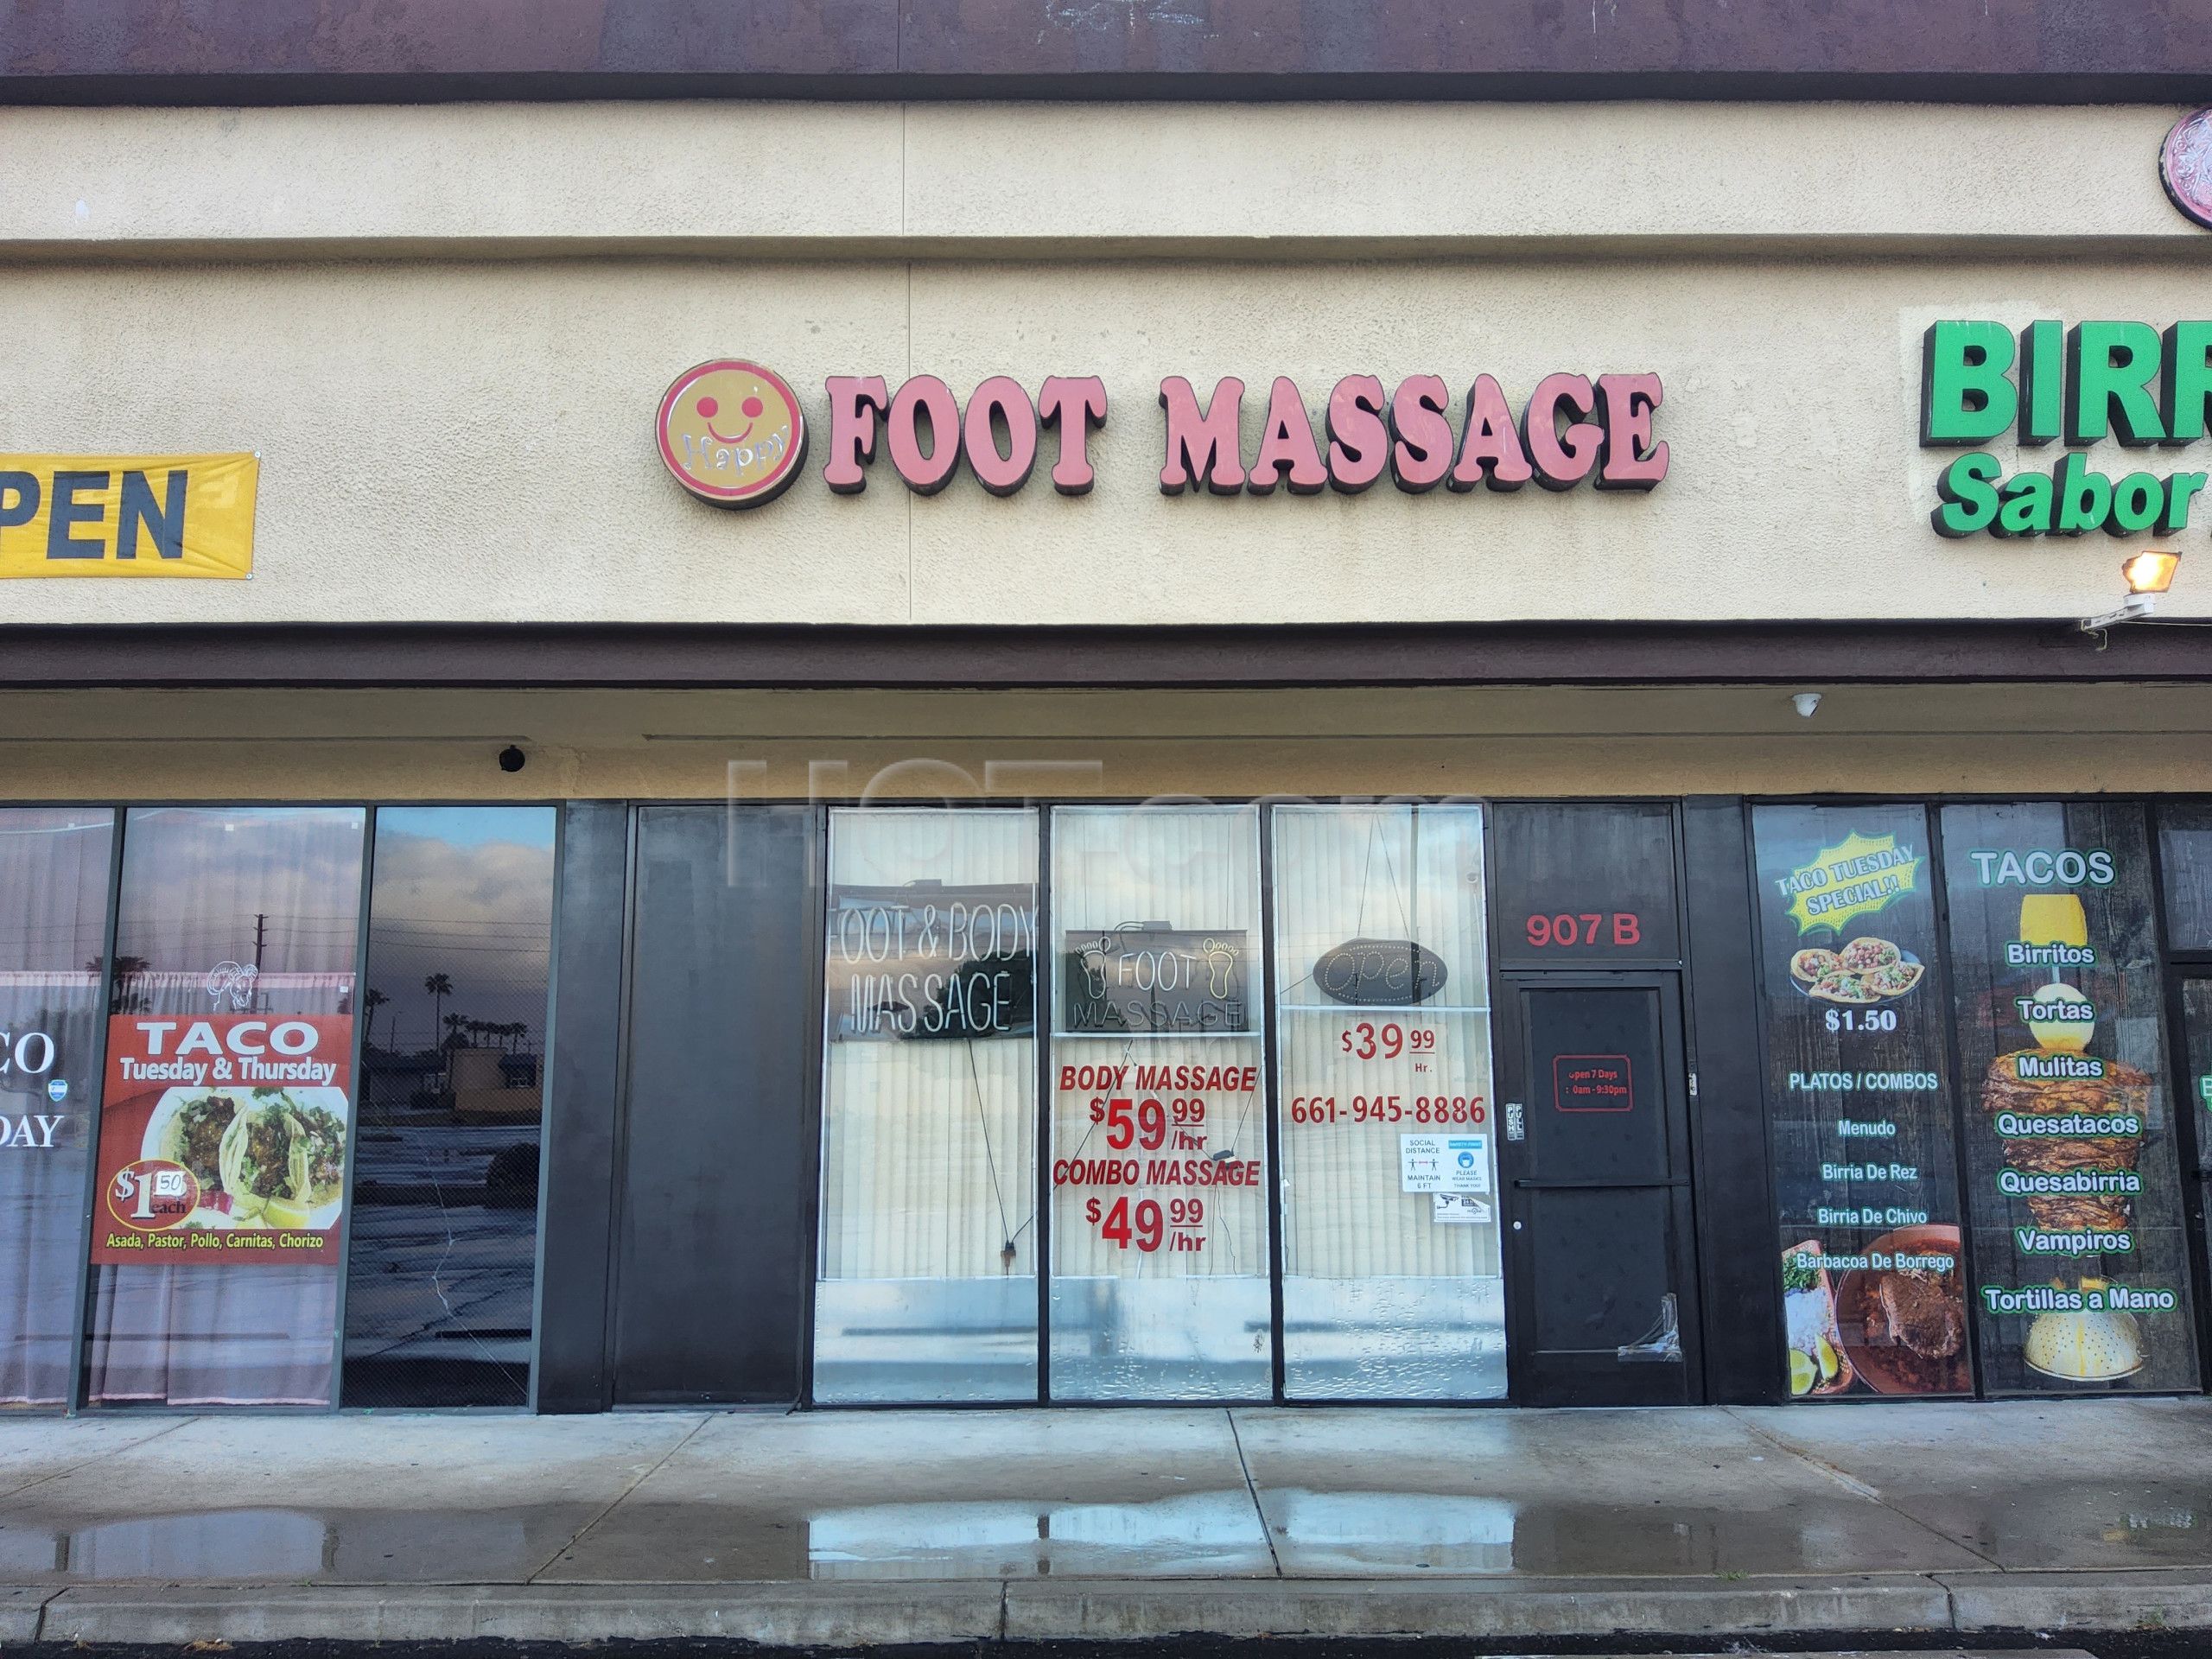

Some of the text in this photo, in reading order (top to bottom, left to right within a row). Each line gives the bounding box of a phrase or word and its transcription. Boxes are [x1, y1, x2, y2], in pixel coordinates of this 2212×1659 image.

[823, 372, 1670, 496] FOOT MASSAGE
[682, 424, 787, 478] Happy
[1930, 452, 2209, 538] Sabor
[1775, 843, 1915, 896] TACO TUESDAY
[1971, 850, 2114, 884] TACOS
[1806, 875, 1899, 914] SPECIAL!!
[918, 904, 937, 959] &
[949, 902, 1039, 962] BODY
[1526, 912, 1641, 946] 907 B
[2007, 944, 2094, 964] Birritos
[1118, 951, 1197, 992] FOOT
[850, 970, 1010, 1033] MASSAGE
[1073, 1001, 1243, 1027] MASSAGE
[2018, 999, 2094, 1020] Tortas
[1825, 1008, 1897, 1033] $1.50
[137, 1021, 319, 1055] TACO
[1341, 1022, 1435, 1060] $39 99
[120, 1057, 337, 1085] Tuesday & Thursday
[1059, 1065, 1257, 1091] BODY MASSAGE
[1414, 1063, 1433, 1072] Hr.
[1591, 1070, 1597, 1078] 7
[1598, 1070, 1618, 1080] Days
[2018, 1057, 2102, 1077] Mulitas
[1566, 1085, 1591, 1094] 0am
[1596, 1084, 1627, 1096] 9:30pm
[1789, 1072, 1938, 1090] PLATOS / COMBOS
[1291, 1096, 1485, 1124] 661-945-8886
[1090, 1096, 1205, 1150] $59 99
[1838, 1119, 1896, 1135] Menudo
[1998, 1114, 2139, 1135] Quesatacos
[1172, 1130, 1208, 1150] /hr
[160, 1174, 181, 1191] 50
[1053, 1160, 1261, 1186] COMBO MASSAGE
[1822, 1164, 1917, 1179] Birria De Rez
[2000, 1171, 2140, 1193] Quesabirria
[151, 1201, 186, 1213] each
[1818, 1208, 1927, 1224] Birria De Chivo
[1086, 1196, 1204, 1253] $49 99
[106, 1233, 323, 1249] Asada, Pastor, Pollo, Carnitas, Chorizo
[1170, 1231, 1207, 1252] /hr
[2018, 1230, 2131, 1255] Vampiros
[1796, 1253, 1955, 1272] Barbacoa De Borrego
[1985, 1288, 2174, 1310] Tortillas a Mano
